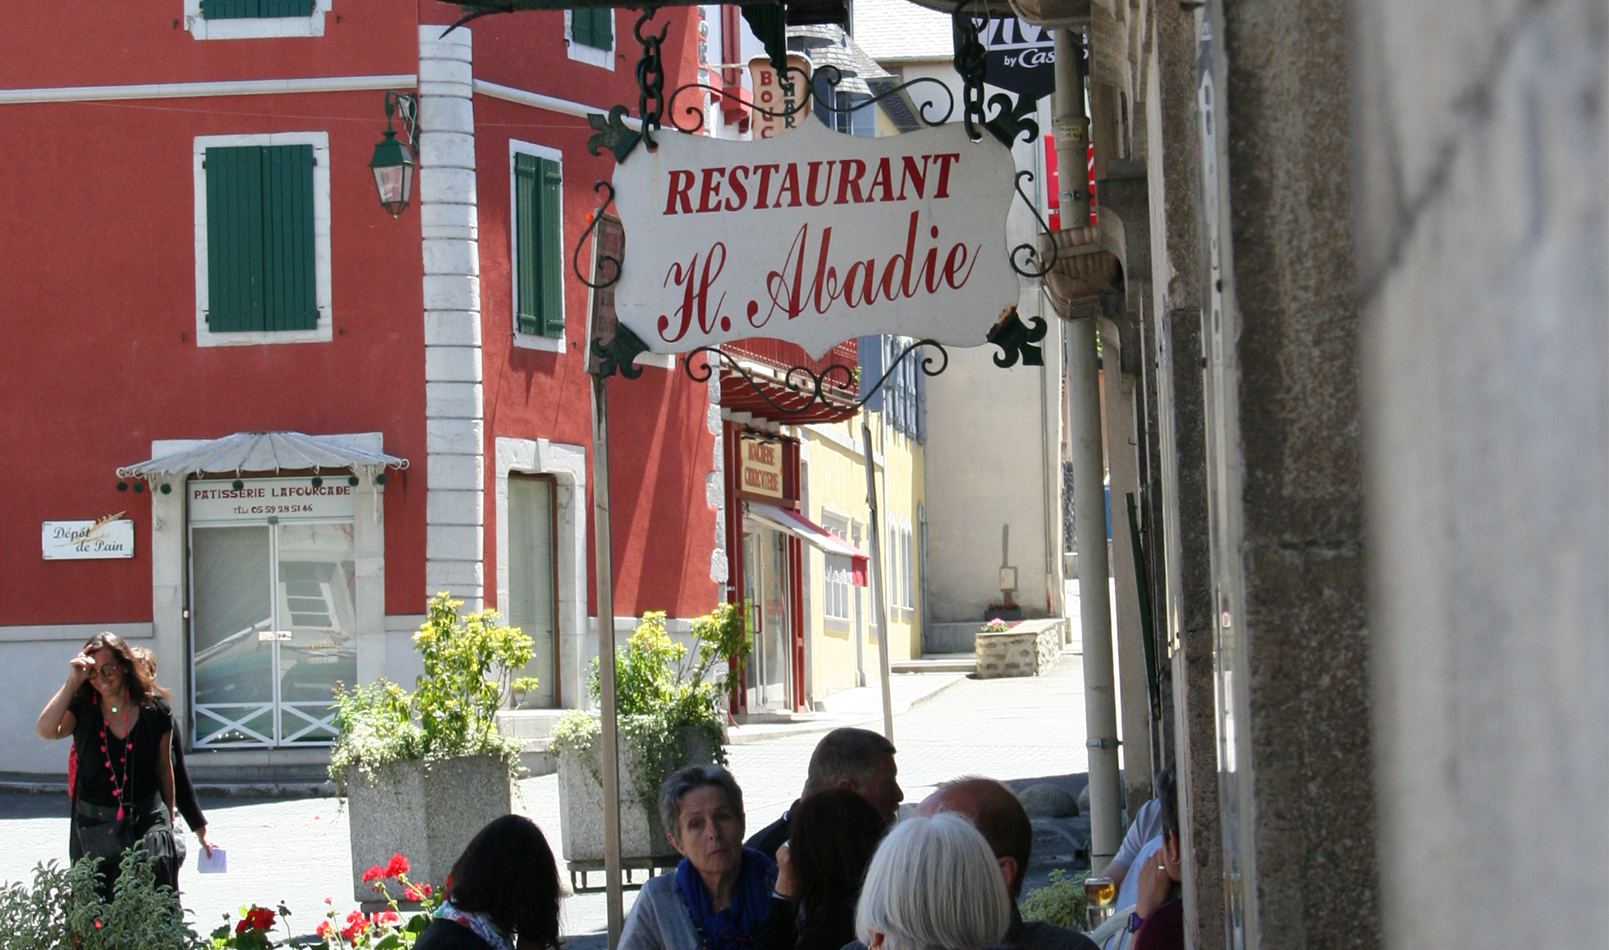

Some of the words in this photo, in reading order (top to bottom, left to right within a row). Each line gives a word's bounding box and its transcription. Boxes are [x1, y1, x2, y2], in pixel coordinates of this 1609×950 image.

[1003, 55, 1018, 68] by
[662, 152, 960, 216] RESTAURANT
[657, 241, 732, 343] H.
[747, 210, 982, 329] Abadie
[271, 485, 351, 497] LAFOURCADE
[251, 505, 263, 514] 05
[265, 505, 276, 514] 59
[278, 505, 290, 513] 28
[302, 503, 313, 512] 46
[53, 526, 91, 542] Dépôt
[76, 541, 91, 553] de
[94, 540, 124, 553] Pain
